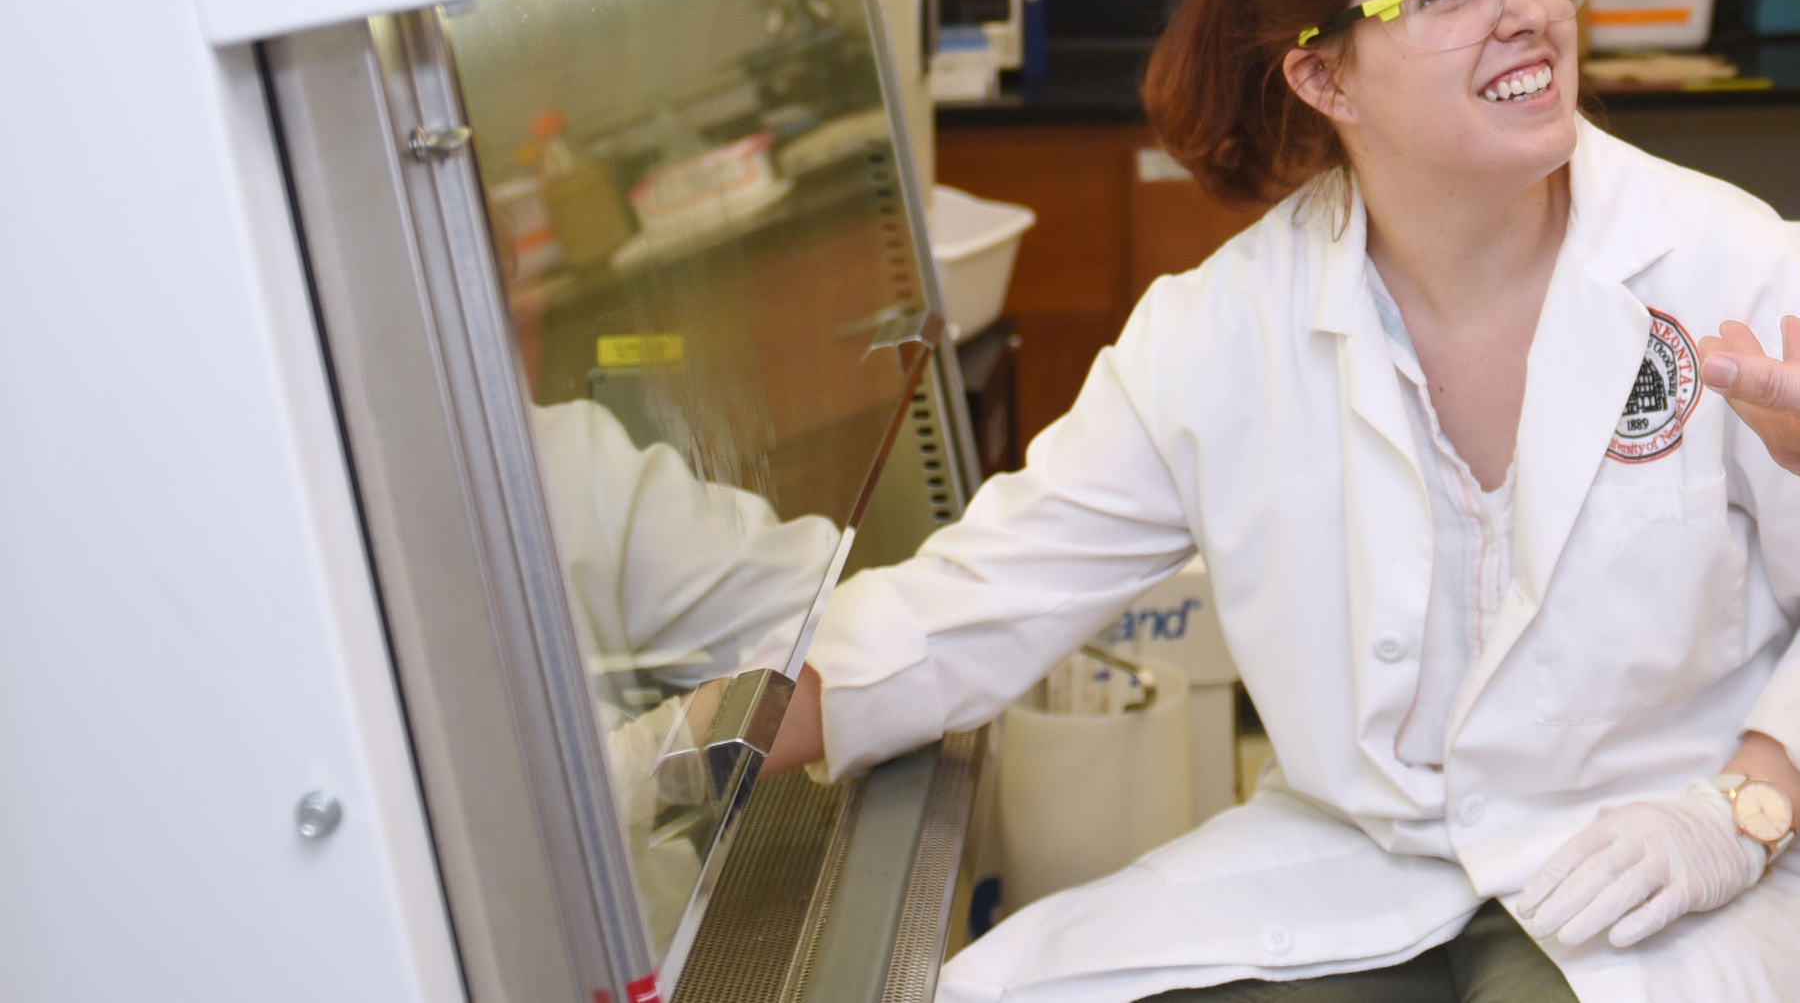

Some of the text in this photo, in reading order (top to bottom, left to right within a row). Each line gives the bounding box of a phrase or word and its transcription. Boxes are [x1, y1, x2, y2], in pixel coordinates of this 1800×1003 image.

[1650, 319, 1693, 387] NEONTA
[1627, 418, 1649, 432] 1889
[1610, 439, 1645, 457] iversity
[1646, 435, 1658, 452] of
